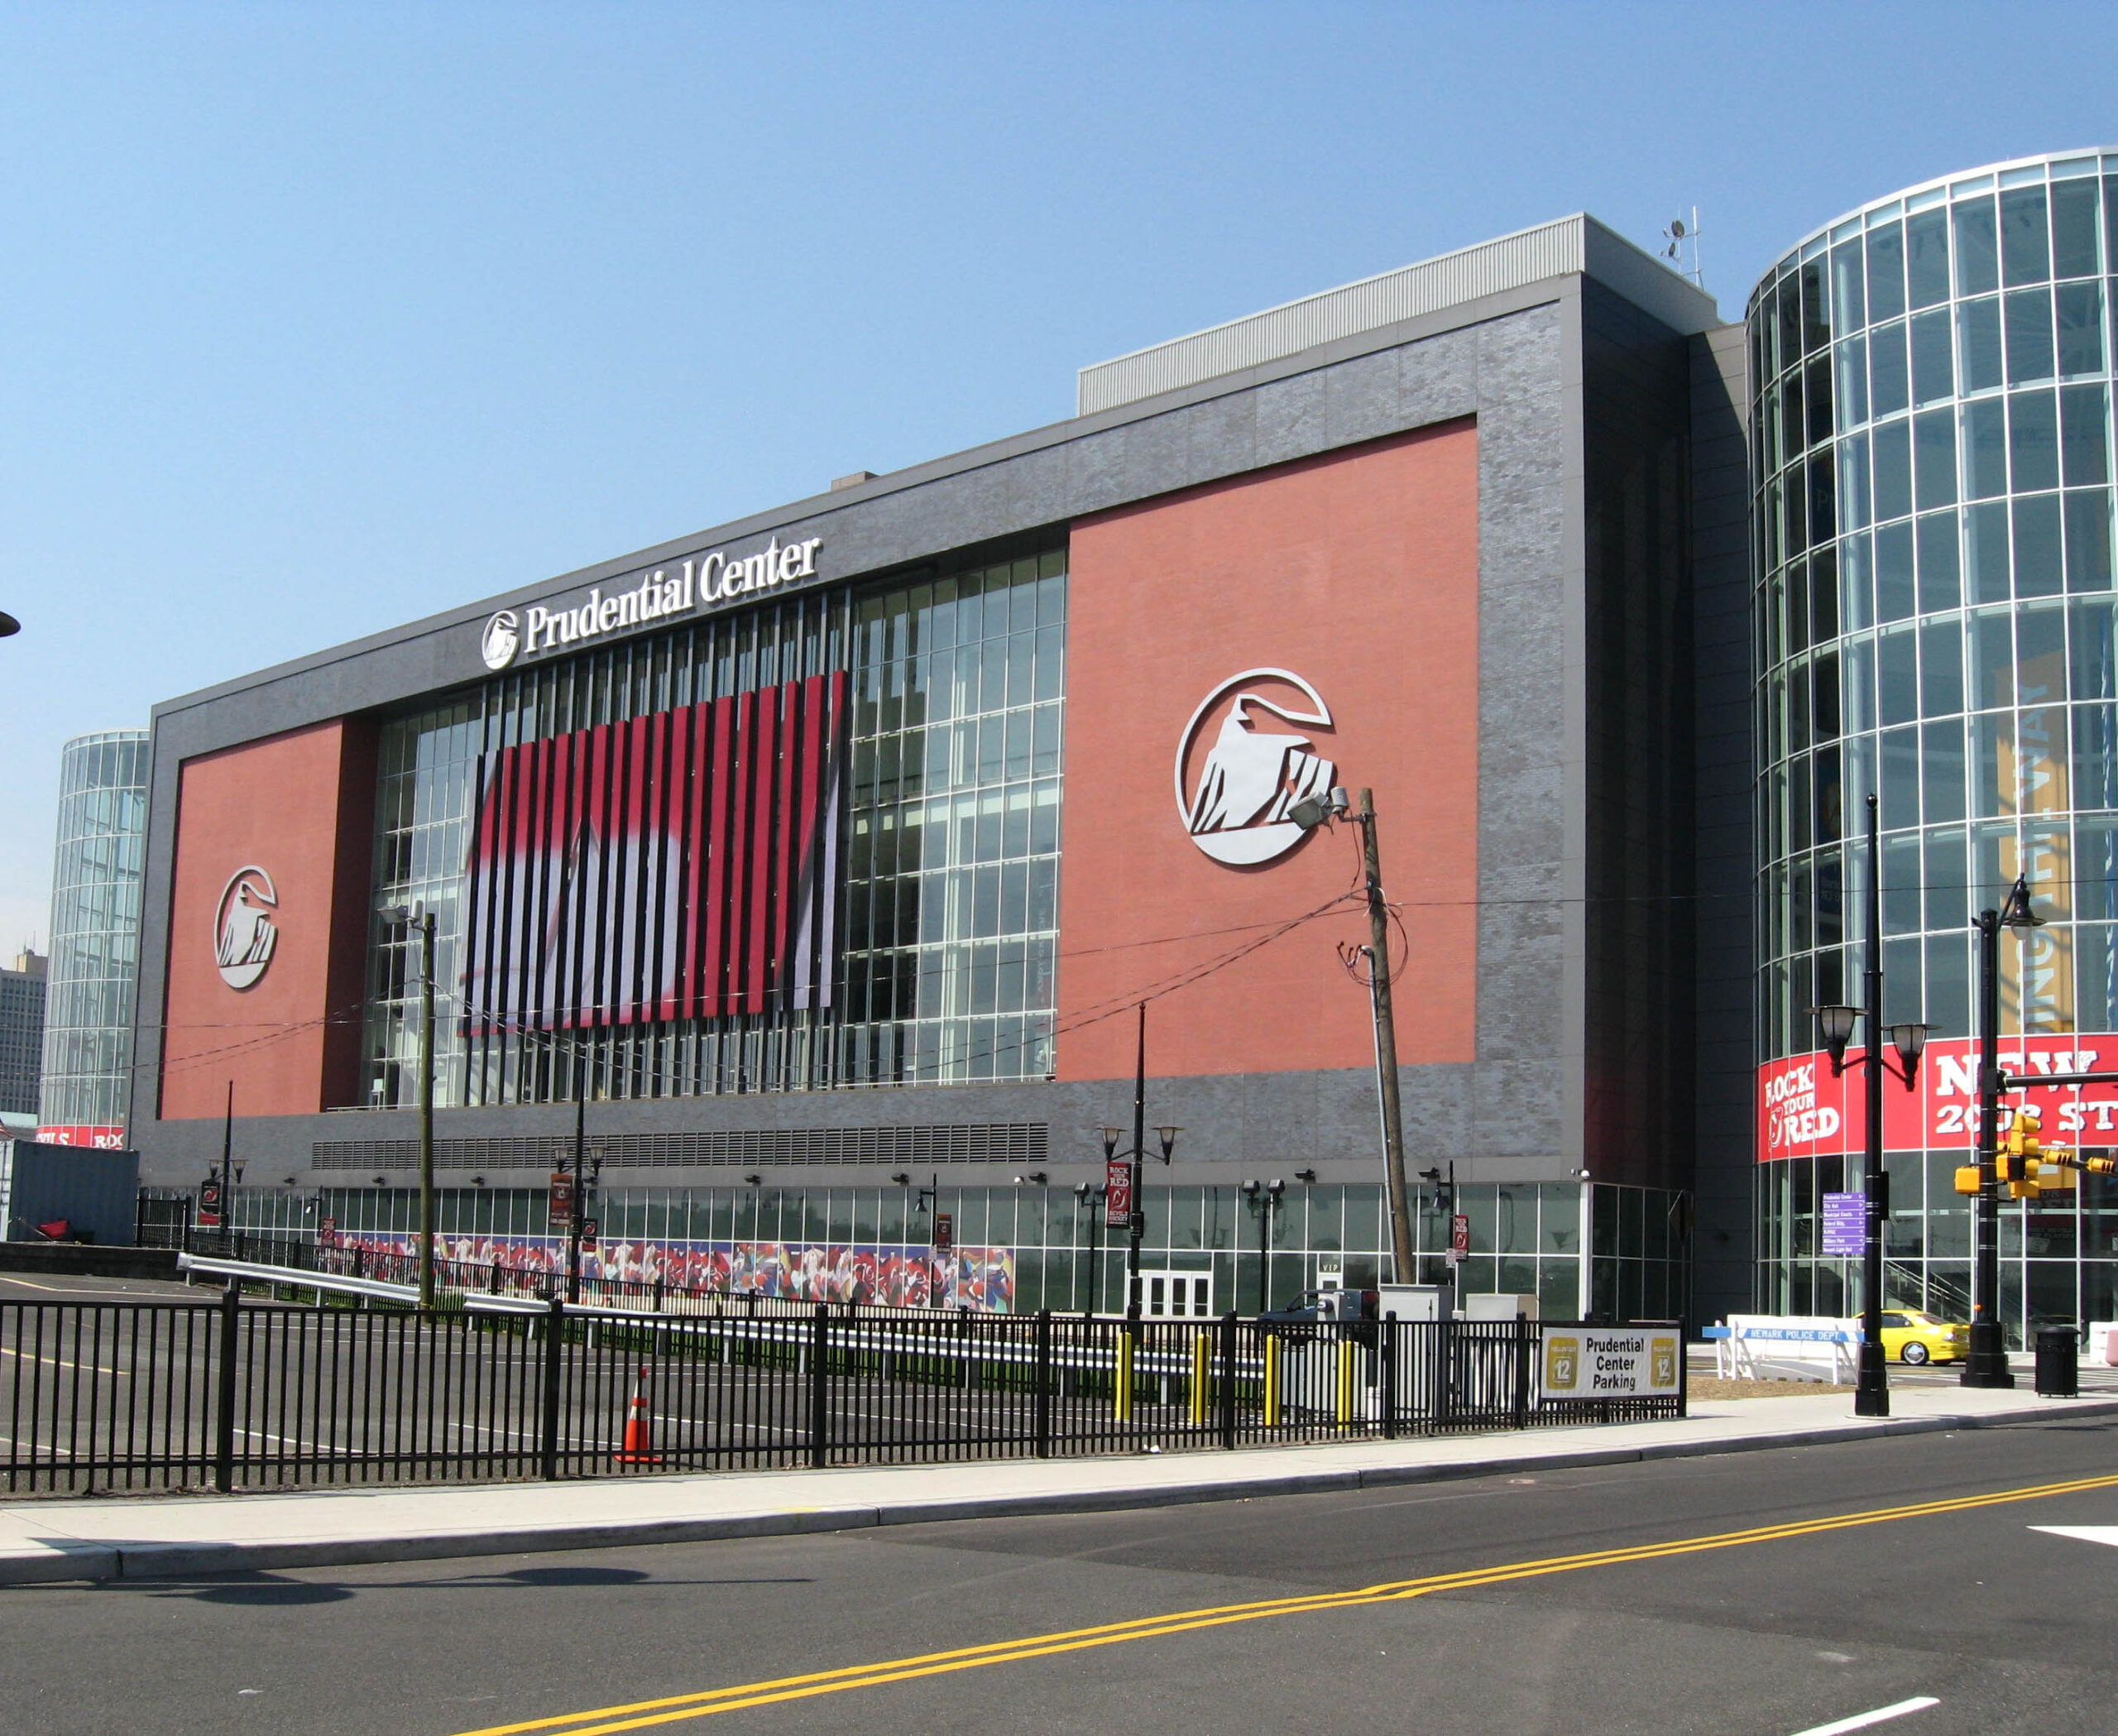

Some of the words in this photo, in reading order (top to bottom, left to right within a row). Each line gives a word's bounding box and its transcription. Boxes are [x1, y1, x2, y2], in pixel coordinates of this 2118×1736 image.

[524, 559, 696, 654] Prudential
[700, 536, 823, 602] Center
[1765, 1062, 1814, 1108] ROCK
[1783, 1092, 1815, 1115] YOUR
[1784, 1107, 1840, 1147] RED
[1109, 1177, 1129, 1187] RED
[1586, 1336, 1645, 1353] Prudential
[1751, 1329, 1783, 1339] NEWARK
[1785, 1330, 1814, 1340] POLICE
[1818, 1331, 1842, 1340] DEPT.
[1555, 1360, 1570, 1381] 12
[1596, 1355, 1636, 1371] Center
[1657, 1359, 1670, 1381] 12
[1592, 1374, 1636, 1392] Parking
